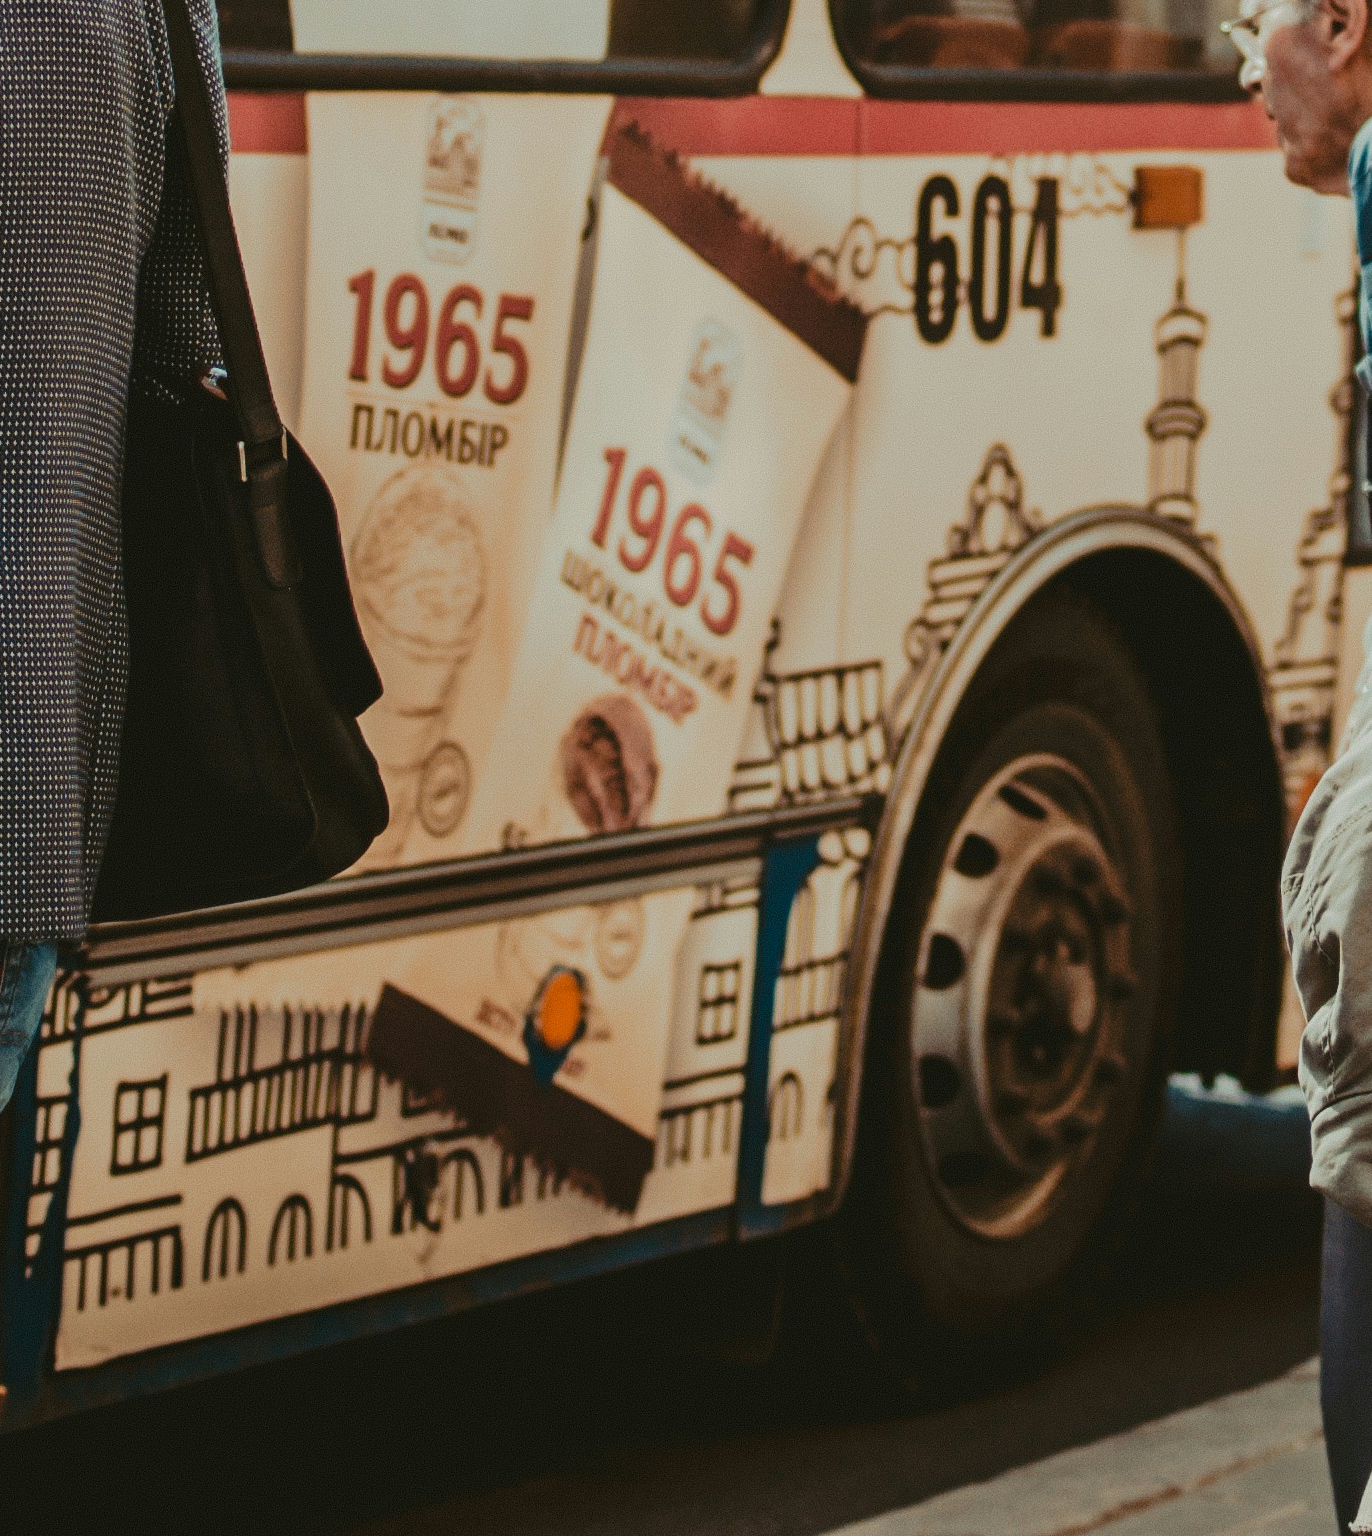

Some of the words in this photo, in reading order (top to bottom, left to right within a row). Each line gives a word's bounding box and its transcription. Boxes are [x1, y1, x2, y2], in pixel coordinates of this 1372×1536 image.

[914, 174, 1064, 344] 604
[347, 267, 536, 406] 1965
[349, 403, 510, 469] ПЛОМБІР
[590, 446, 755, 636] 1965
[572, 612, 699, 727] ПЛОМБІР
